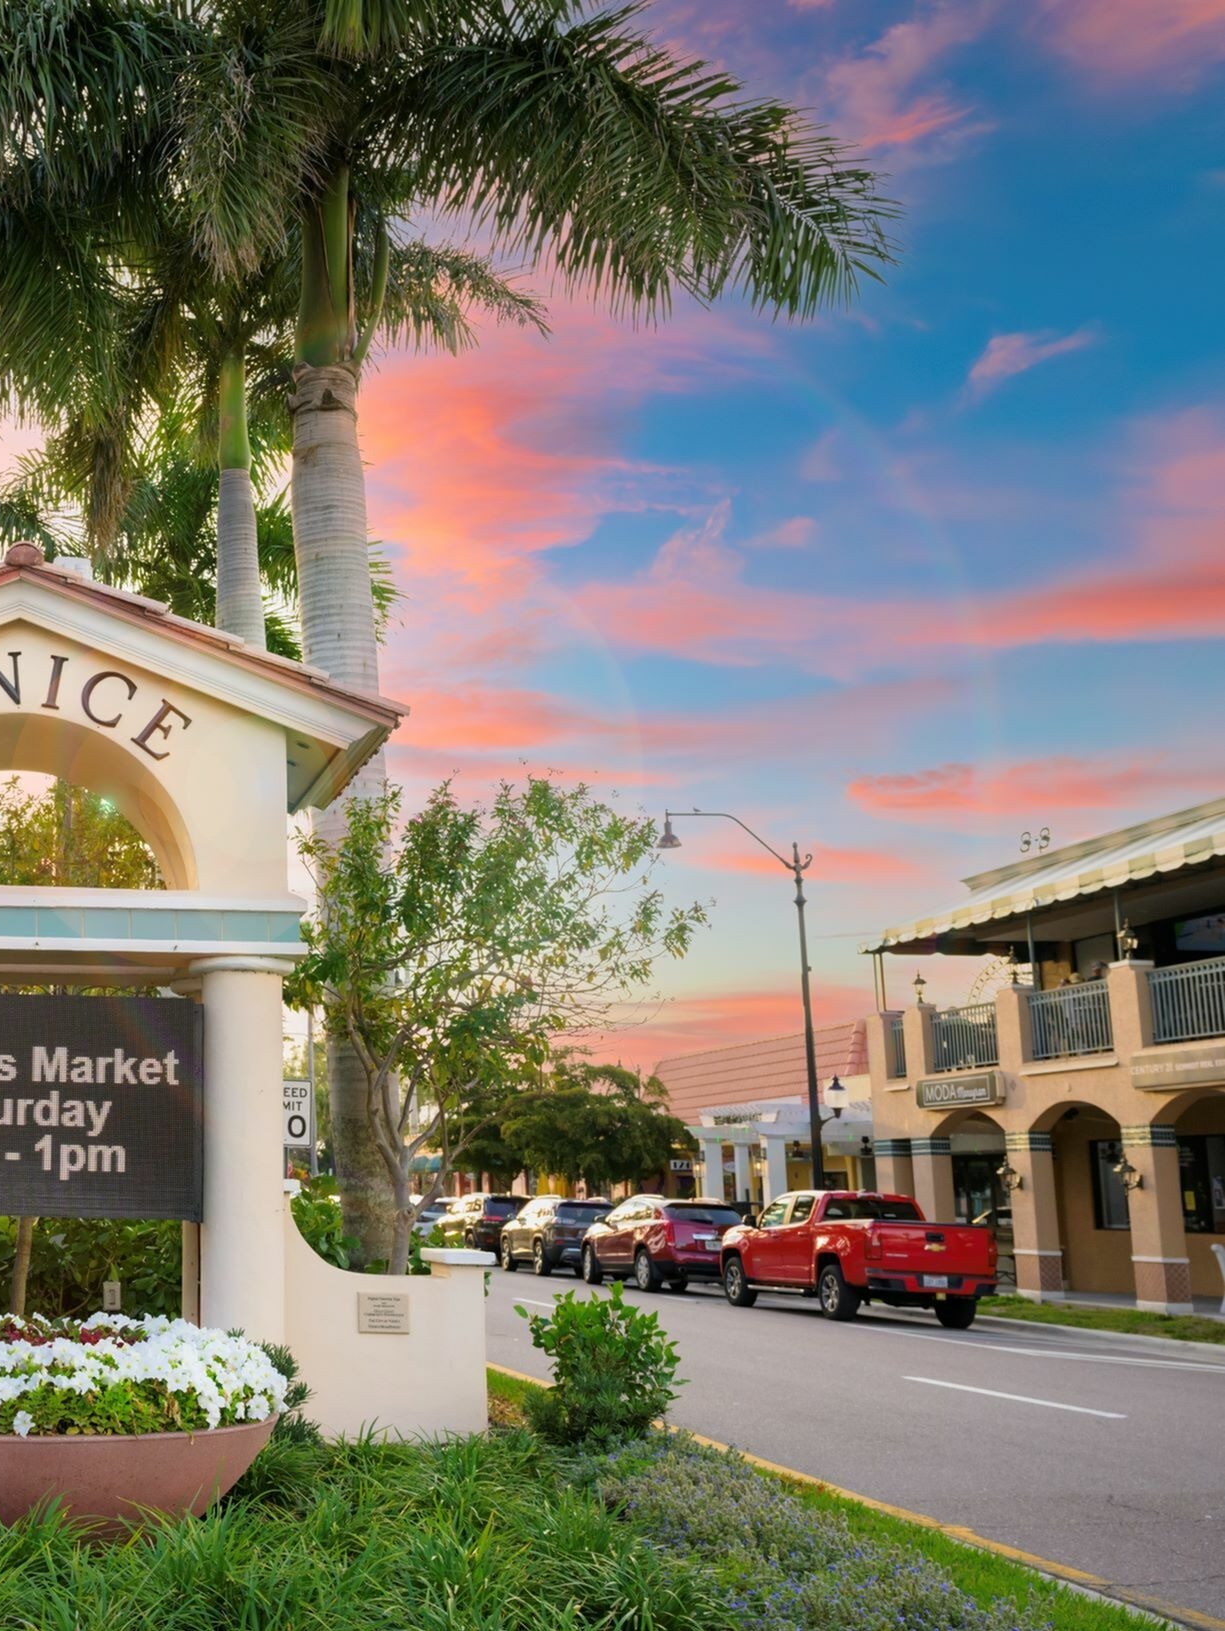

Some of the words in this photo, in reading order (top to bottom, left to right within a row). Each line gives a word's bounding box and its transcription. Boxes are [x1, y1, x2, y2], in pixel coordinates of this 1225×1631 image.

[31, 1046, 180, 1085] Market
[283, 1087, 308, 1098] EED
[925, 1083, 956, 1102] MODA
[283, 1101, 303, 1111] MIT
[288, 1114, 306, 1138] 0
[4, 1152, 21, 1160] -
[34, 1134, 126, 1180] 1pm
